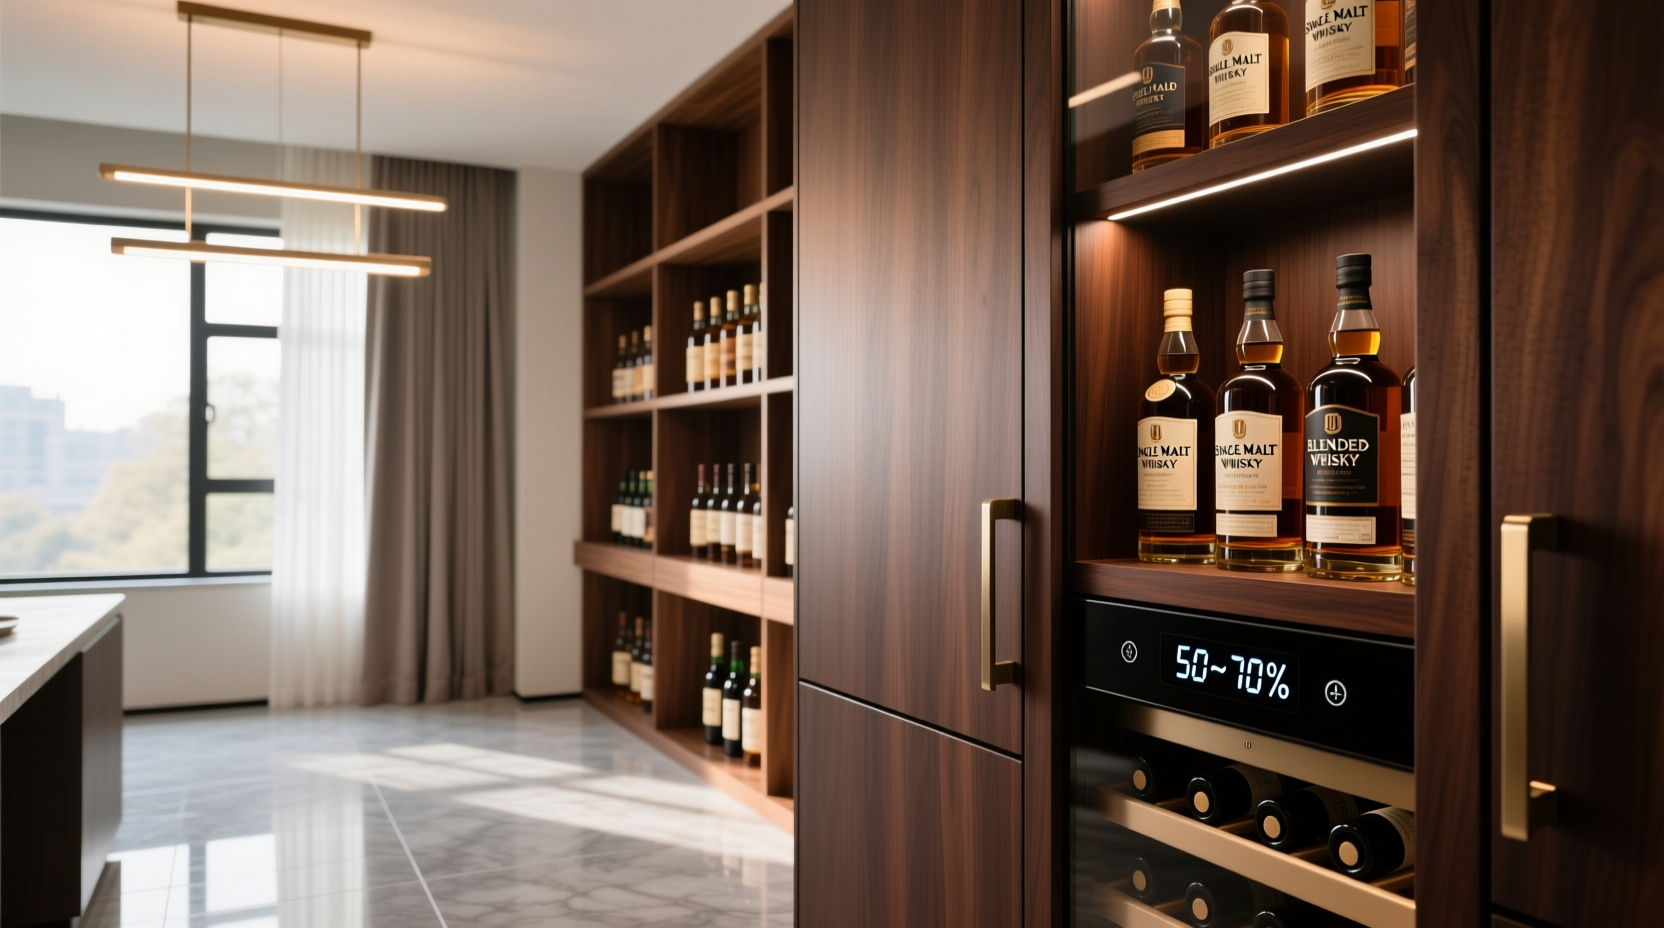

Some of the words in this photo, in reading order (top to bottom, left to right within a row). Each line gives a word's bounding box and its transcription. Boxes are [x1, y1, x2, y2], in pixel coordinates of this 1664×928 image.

[1232, 53, 1262, 68] MALT
[1243, 443, 1278, 456] MALT
[1307, 438, 1370, 453] BLENDED
[1310, 453, 1360, 467] WHISKY
[1176, 644, 1290, 700] 50~70%
